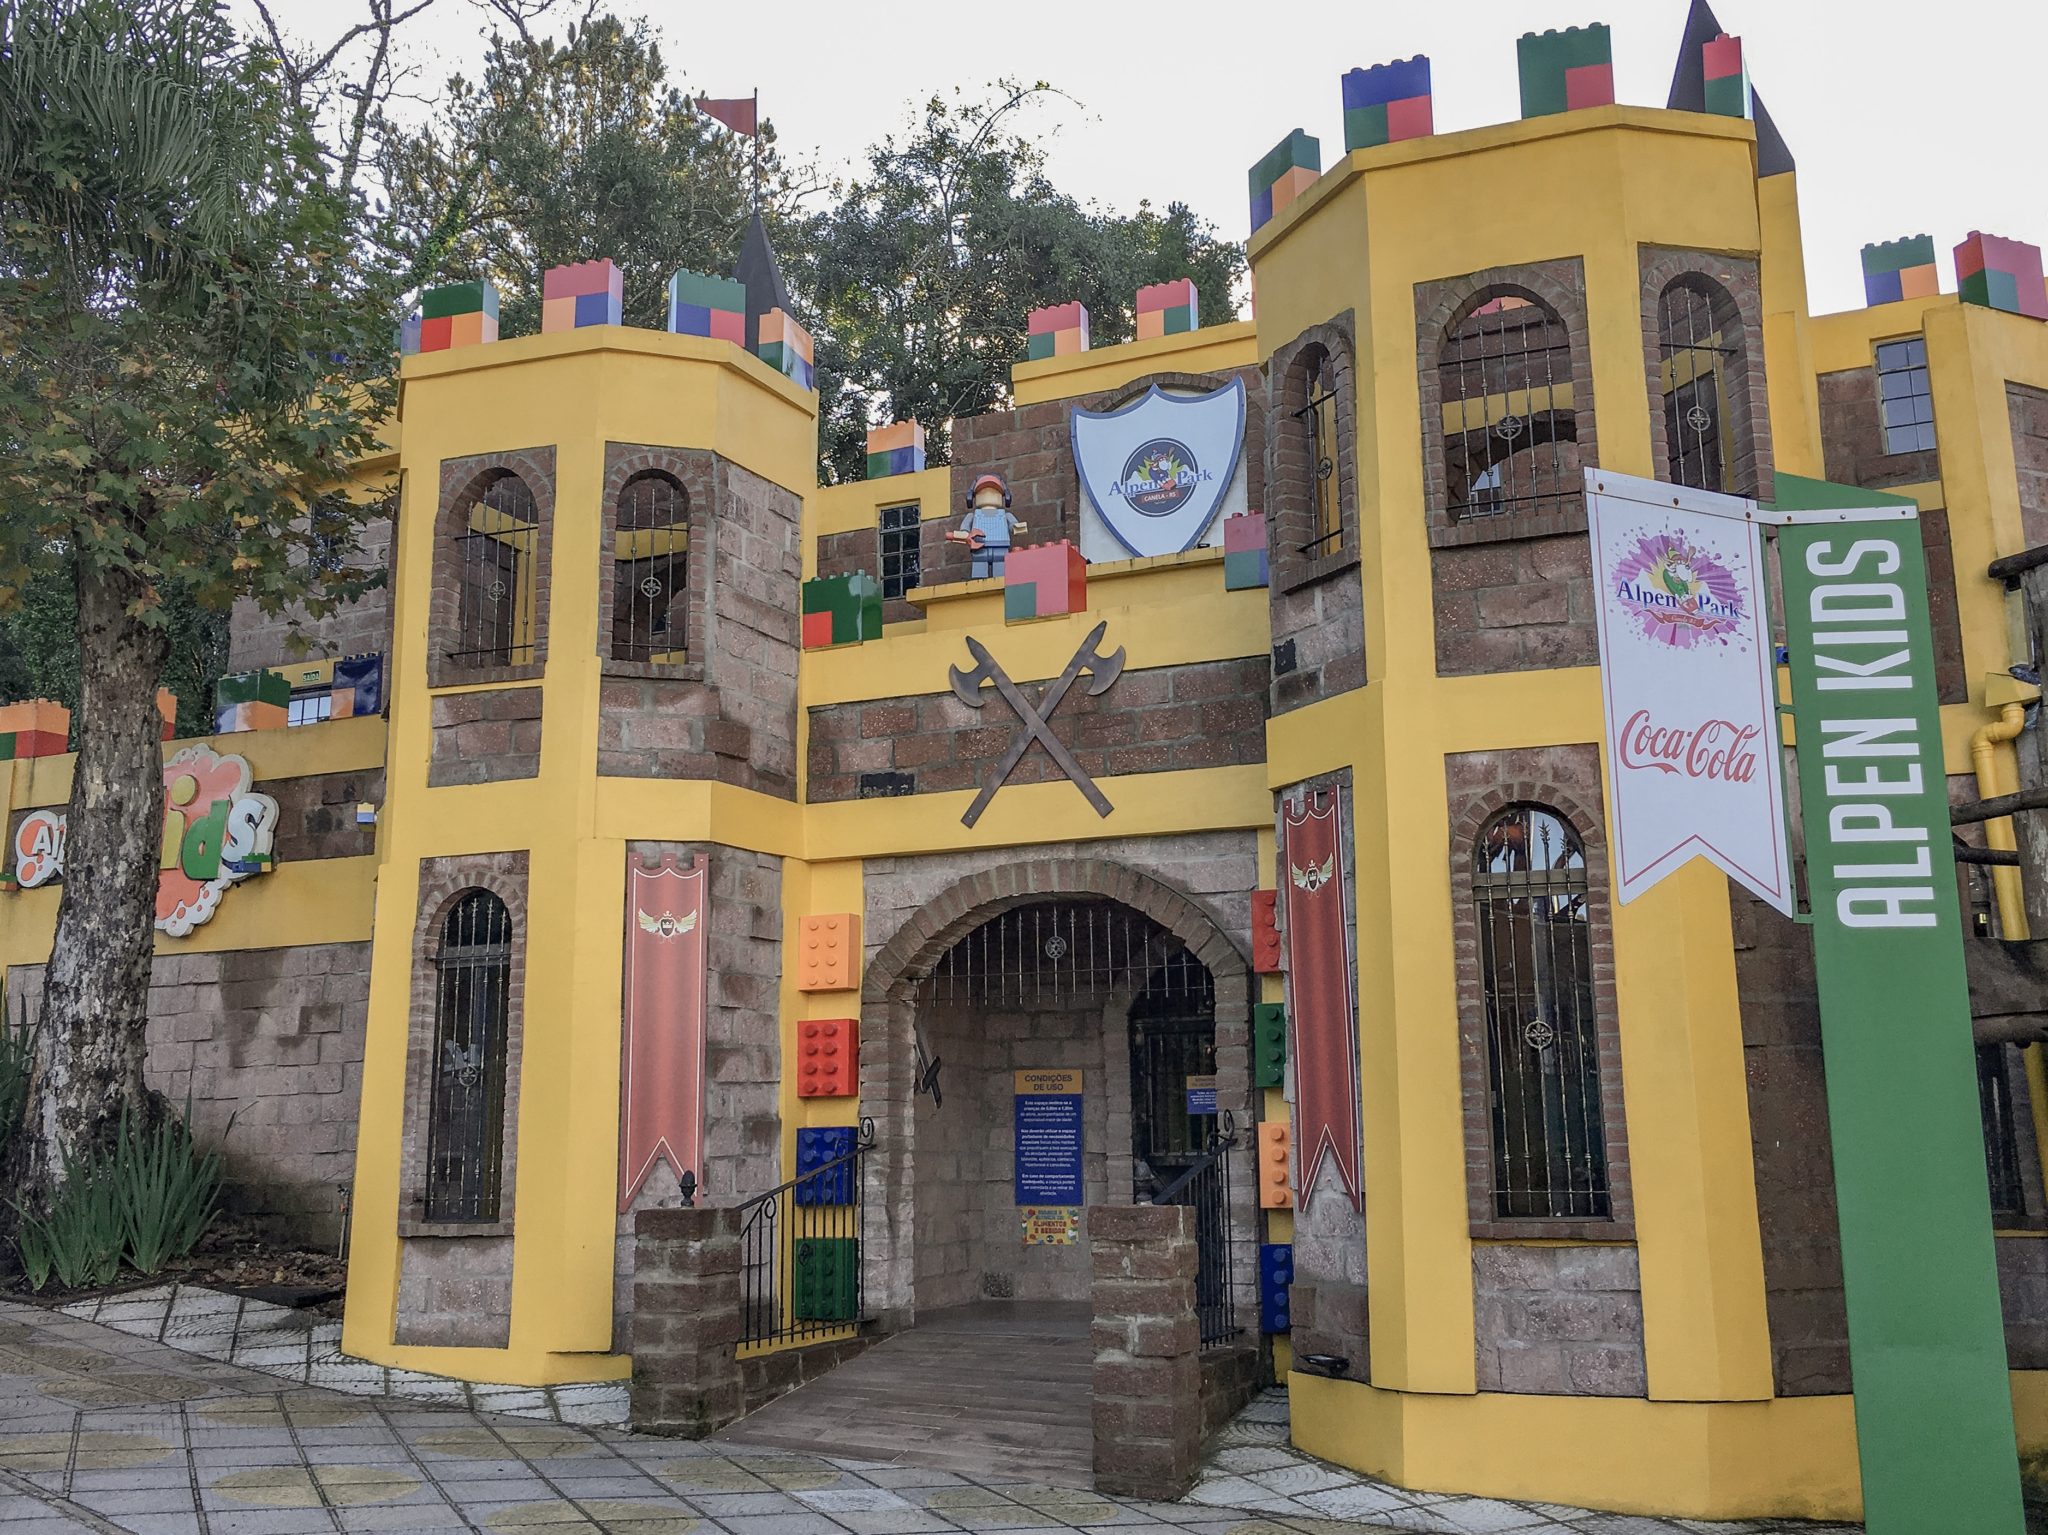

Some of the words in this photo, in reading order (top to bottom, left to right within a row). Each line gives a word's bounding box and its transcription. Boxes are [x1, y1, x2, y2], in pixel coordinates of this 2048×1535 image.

[1108, 479, 1158, 498] Alpen
[1176, 470, 1213, 485] Park
[1616, 578, 1678, 607] Alpen
[1698, 593, 1740, 618] Park
[1805, 538, 1914, 691] KIDS
[1619, 709, 1762, 783] Coca-Cola
[1820, 717, 1938, 928] ALPEN
[1024, 1073, 1073, 1083] CONDIÇÕES
[1033, 1083, 1044, 1091] DE
[1046, 1083, 1064, 1091] USO
